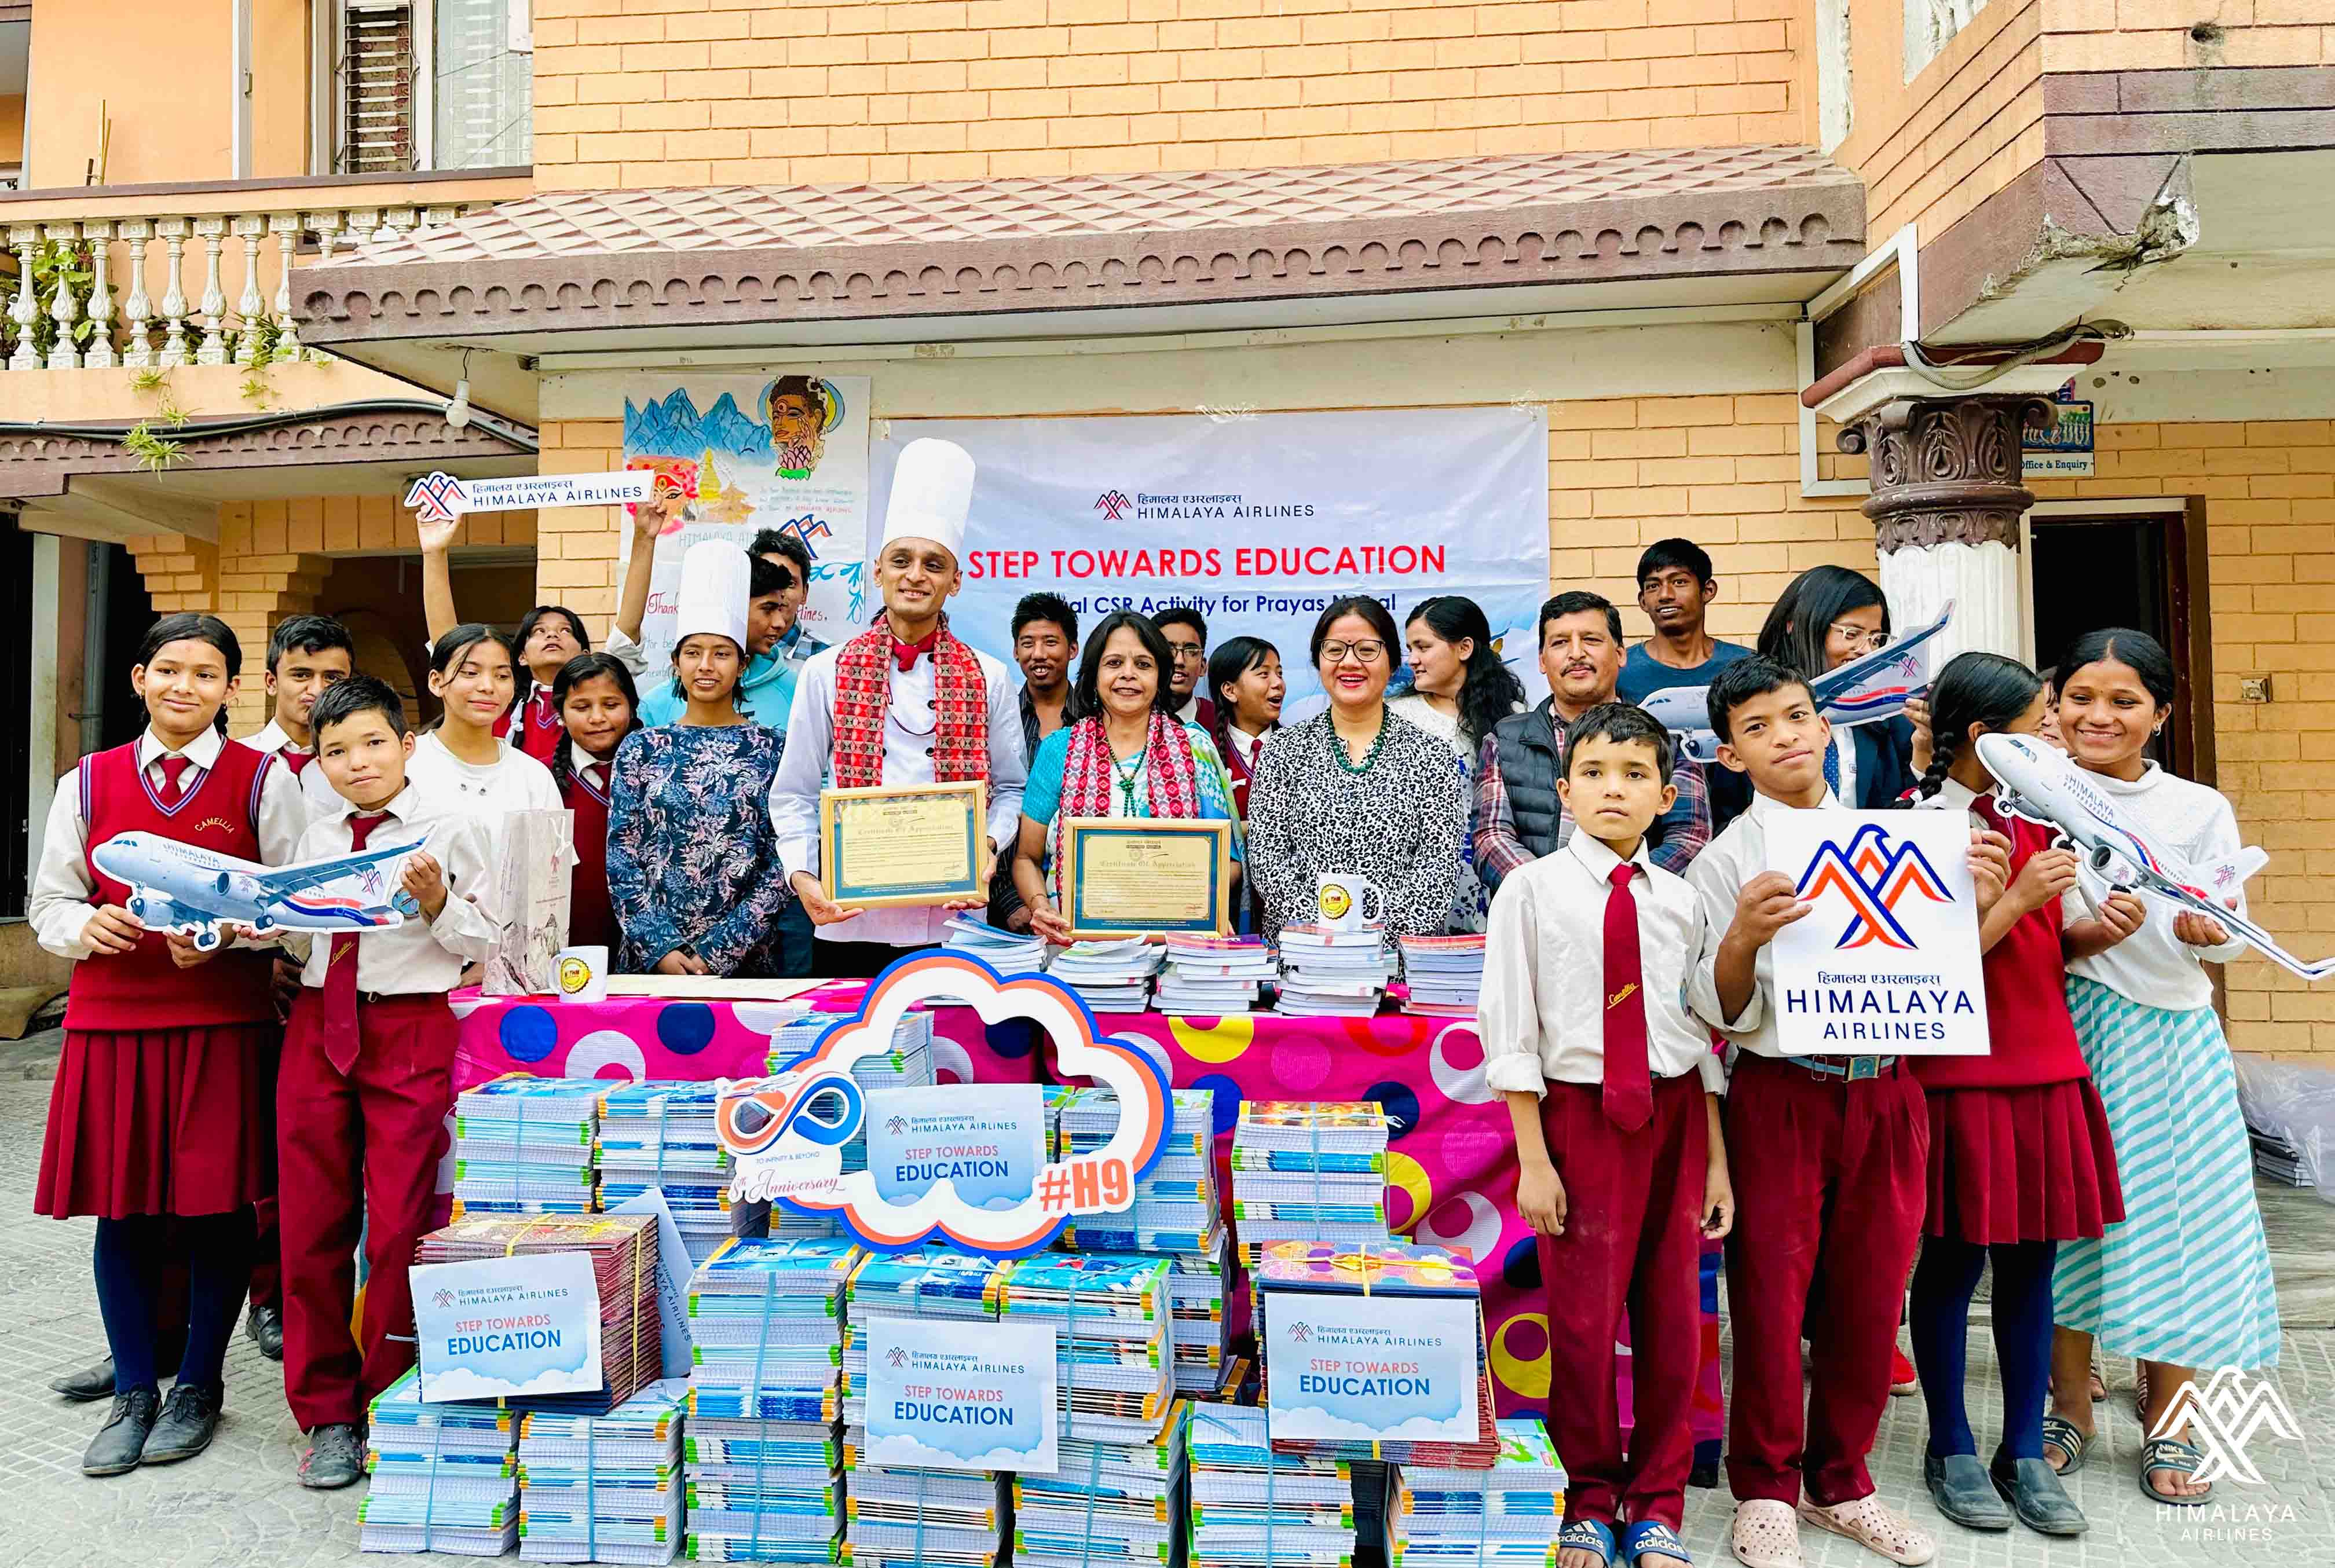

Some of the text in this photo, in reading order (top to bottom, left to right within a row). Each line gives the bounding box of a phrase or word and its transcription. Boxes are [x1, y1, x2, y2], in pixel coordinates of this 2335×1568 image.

[2056, 460, 2087, 470] Enquiry
[473, 483, 513, 494] हिमालय
[474, 486, 642, 507] HIMALAYA AIRLINES
[1138, 493, 1178, 504] हिमालय
[1138, 505, 1315, 519] HIMALAYA AIRLINES
[968, 545, 1445, 579] STEP TOWARDS EDUCATION
[1094, 597, 1133, 614] CSR
[1140, 596, 1214, 616] Activity
[1223, 596, 1251, 612] for
[1257, 596, 1325, 616] Prayas
[2070, 775, 2113, 819] HIMALAYA
[195, 817, 235, 834] CAMELLIA
[1818, 971, 1866, 984] हिमालय
[1787, 990, 1974, 1014] HIMALAYA
[1824, 1023, 1945, 1040] AIRLINES
[912, 1123, 964, 1133] HIMALAYA
[905, 1145, 998, 1160] STEP TOWARDS
[896, 1160, 1008, 1181] EDUCATION
[749, 1168, 846, 1200] Anniversary
[1039, 1158, 1128, 1211] #H9
[459, 1288, 569, 1306] HIMALAYA AIRLINES
[455, 1314, 551, 1333] STEP TOWARDS
[667, 1296, 691, 1341] AIRLINES
[448, 1329, 560, 1355] EDUCATION
[1317, 1335, 1441, 1346] HIMALAYA AIRLINES
[912, 1362, 1024, 1373] HIMALAYA AIRLINES
[1311, 1358, 1418, 1374] STEP TOWARDS
[905, 1384, 1002, 1402] STEP TOWARDS
[1300, 1375, 1430, 1395] EDUCATION
[895, 1402, 1013, 1425] EDUCATION
[2159, 1444, 2184, 1455] NIKE
[1558, 1533, 1603, 1548] adidas
[1635, 1537, 1685, 1554] adidas
